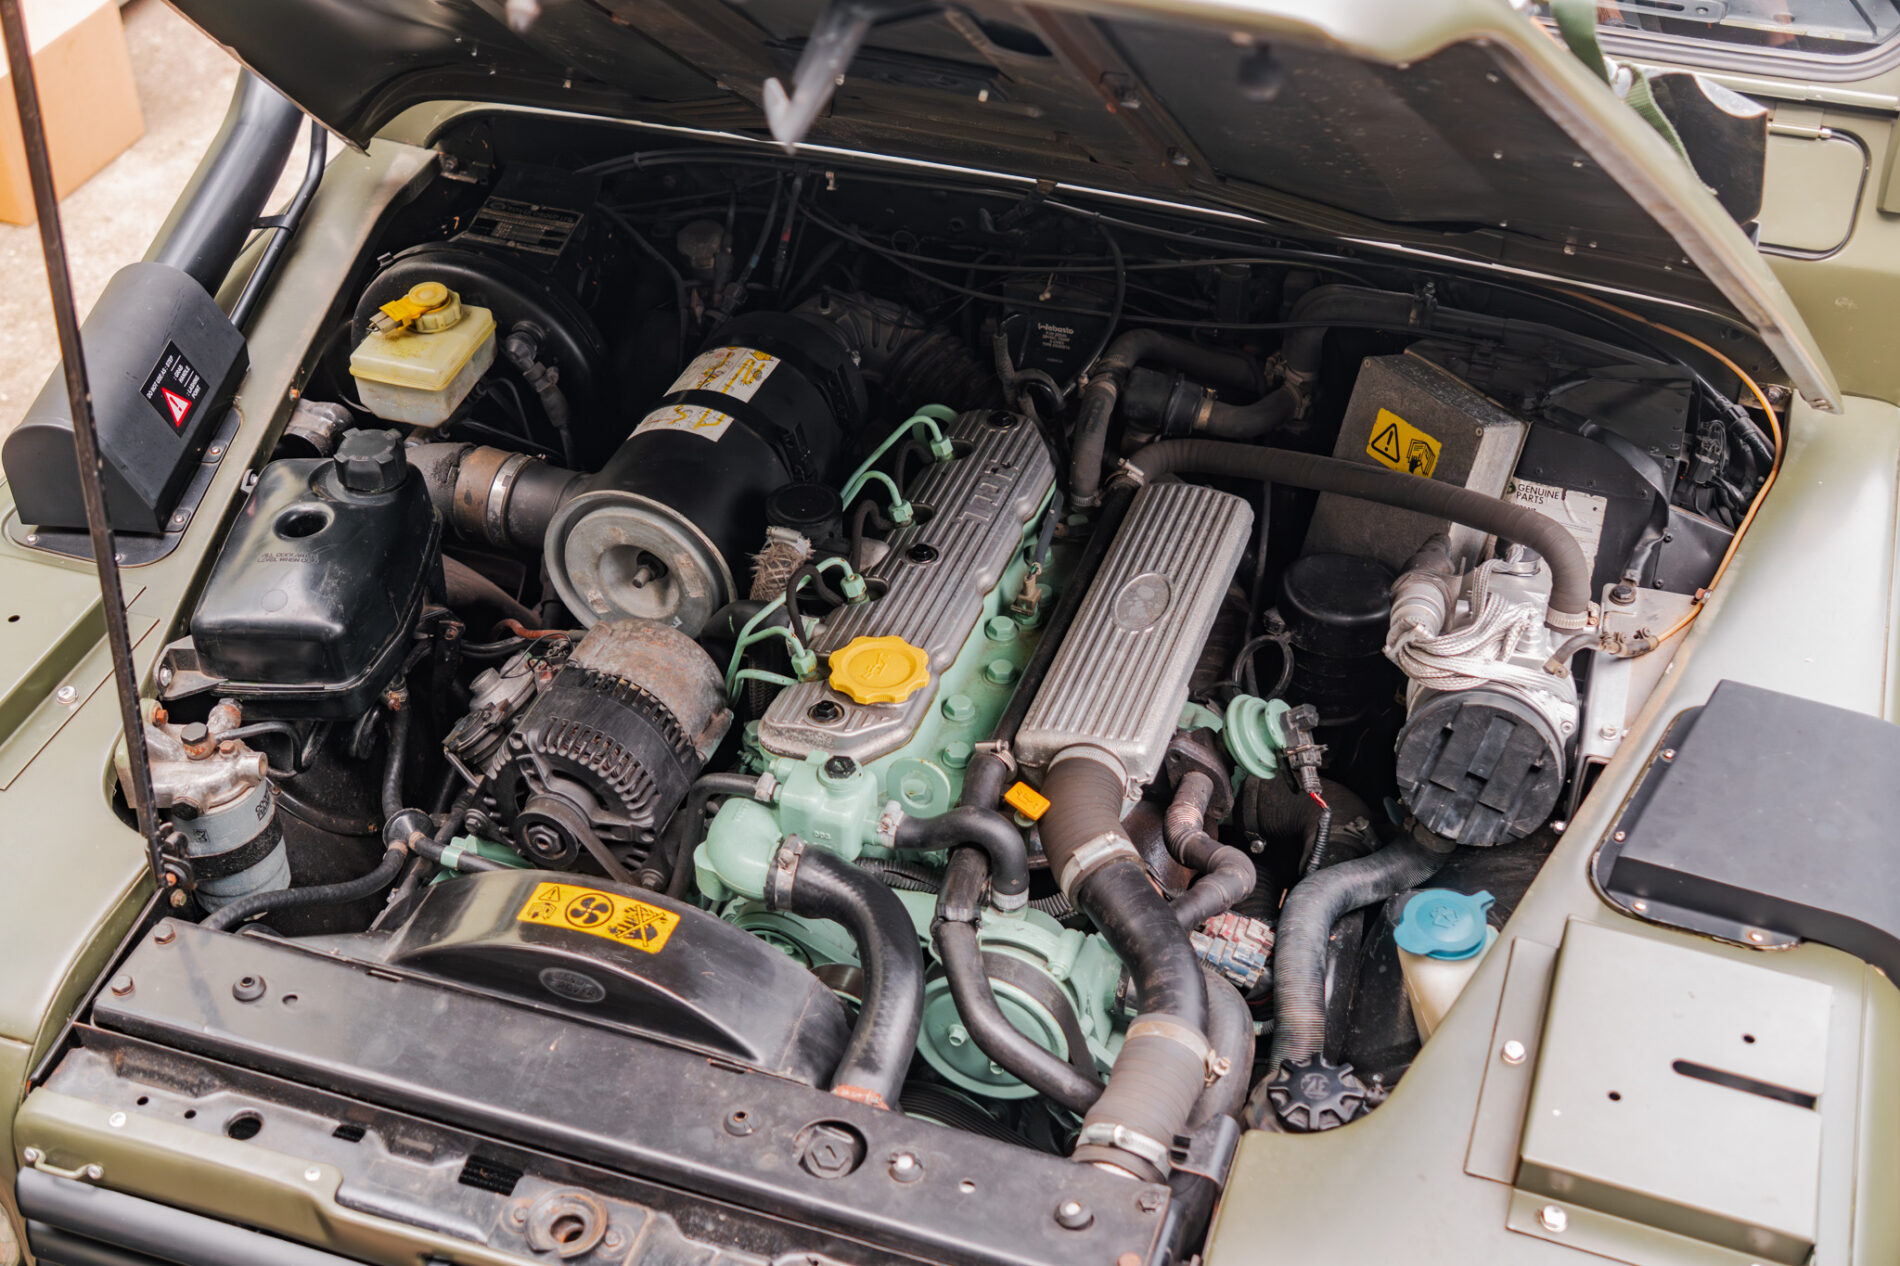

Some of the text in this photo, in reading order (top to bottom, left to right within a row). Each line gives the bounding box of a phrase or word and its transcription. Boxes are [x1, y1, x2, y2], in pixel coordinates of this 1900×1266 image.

[1037, 322, 1074, 334] Webasto
[165, 355, 173, 367] STEP
[174, 364, 183, 378] GRAB
[178, 365, 190, 383] HANDLE
[188, 375, 199, 393] LASHING
[191, 384, 201, 399] POINT
[1516, 491, 1544, 505] PARTS
[1517, 483, 1560, 500] GENUINE
